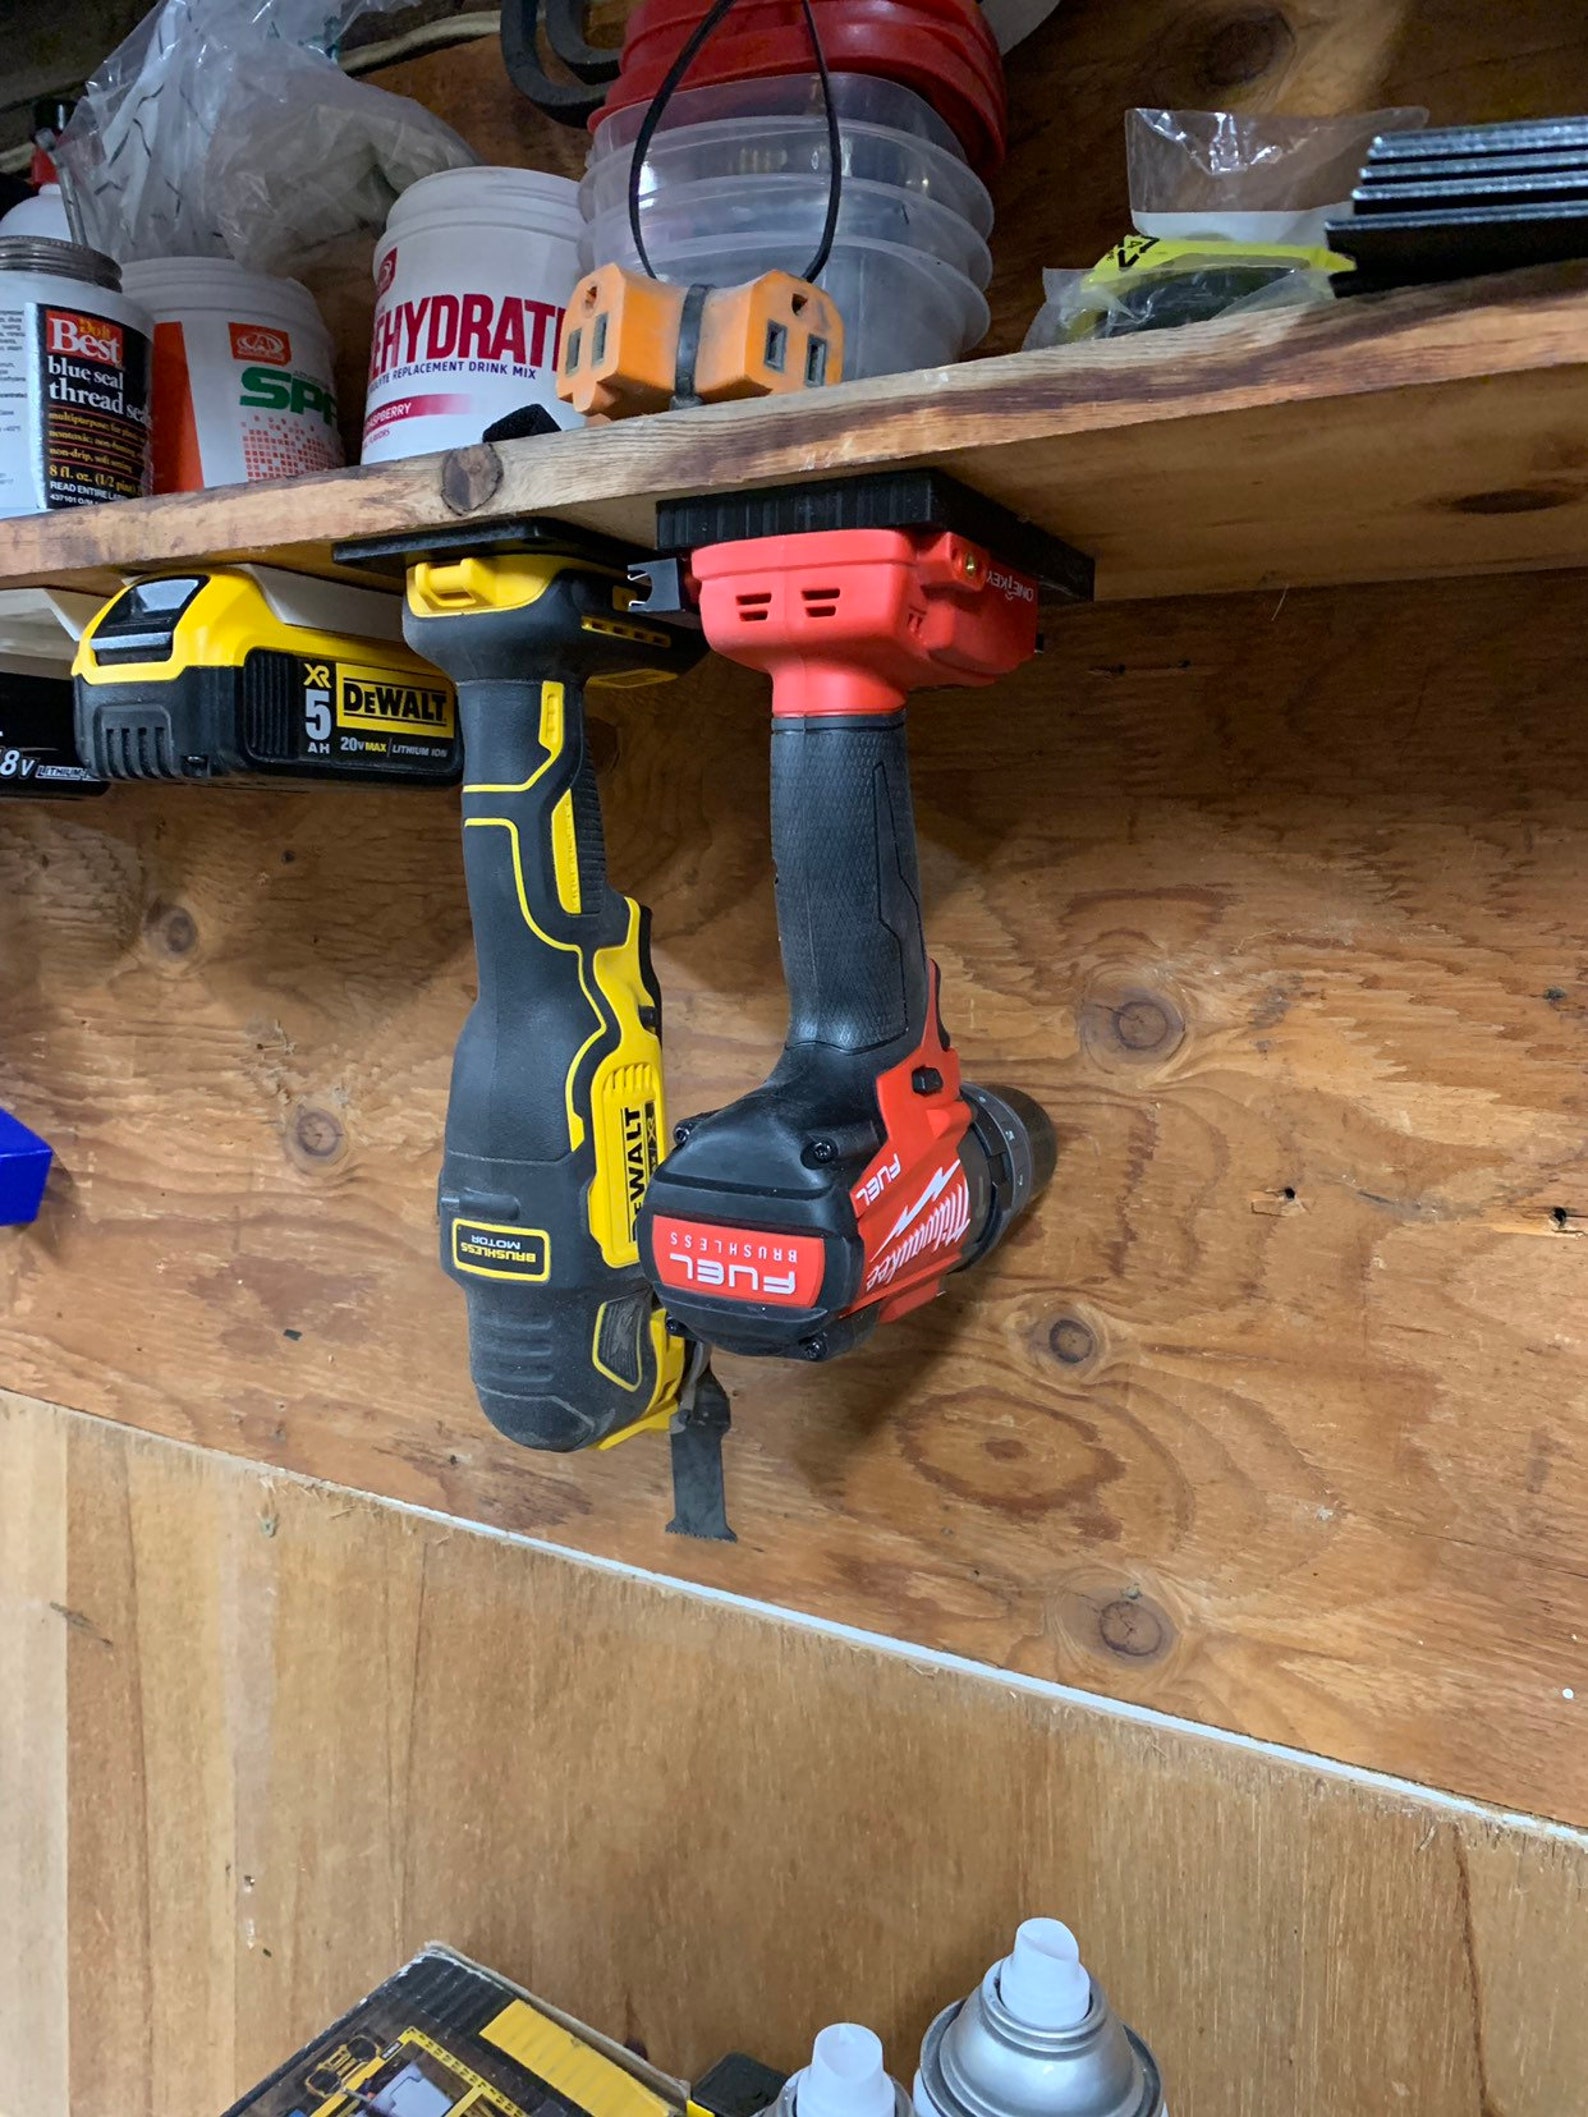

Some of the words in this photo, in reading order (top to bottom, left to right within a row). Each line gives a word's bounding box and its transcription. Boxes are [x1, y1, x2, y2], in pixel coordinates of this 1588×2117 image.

[49, 317, 120, 364] Best
[47, 355, 92, 381] blue
[93, 371, 124, 391] seal
[393, 361, 464, 380] REPLACEMENT
[468, 361, 507, 375] DRINK
[512, 365, 536, 380] MIX
[49, 377, 124, 415] thread
[49, 464, 58, 477] 8
[60, 465, 74, 479] fl.
[76, 472, 93, 482] oz.
[49, 480, 77, 493] READ
[77, 485, 108, 500] ENTIRE
[303, 663, 332, 688] XR
[305, 688, 331, 741] 5
[307, 742, 331, 755] AH
[392, 744, 430, 757] LITHIUM
[431, 748, 449, 758] ION
[856, 1153, 901, 1206] FUEL
[471, 1234, 521, 1250] MOTOR
[866, 1174, 971, 1292] Milwaukee
[460, 1242, 536, 1263] BRUSHLESS
[670, 1232, 798, 1263] BRUSHLESS
[669, 1252, 796, 1295] FUEL
